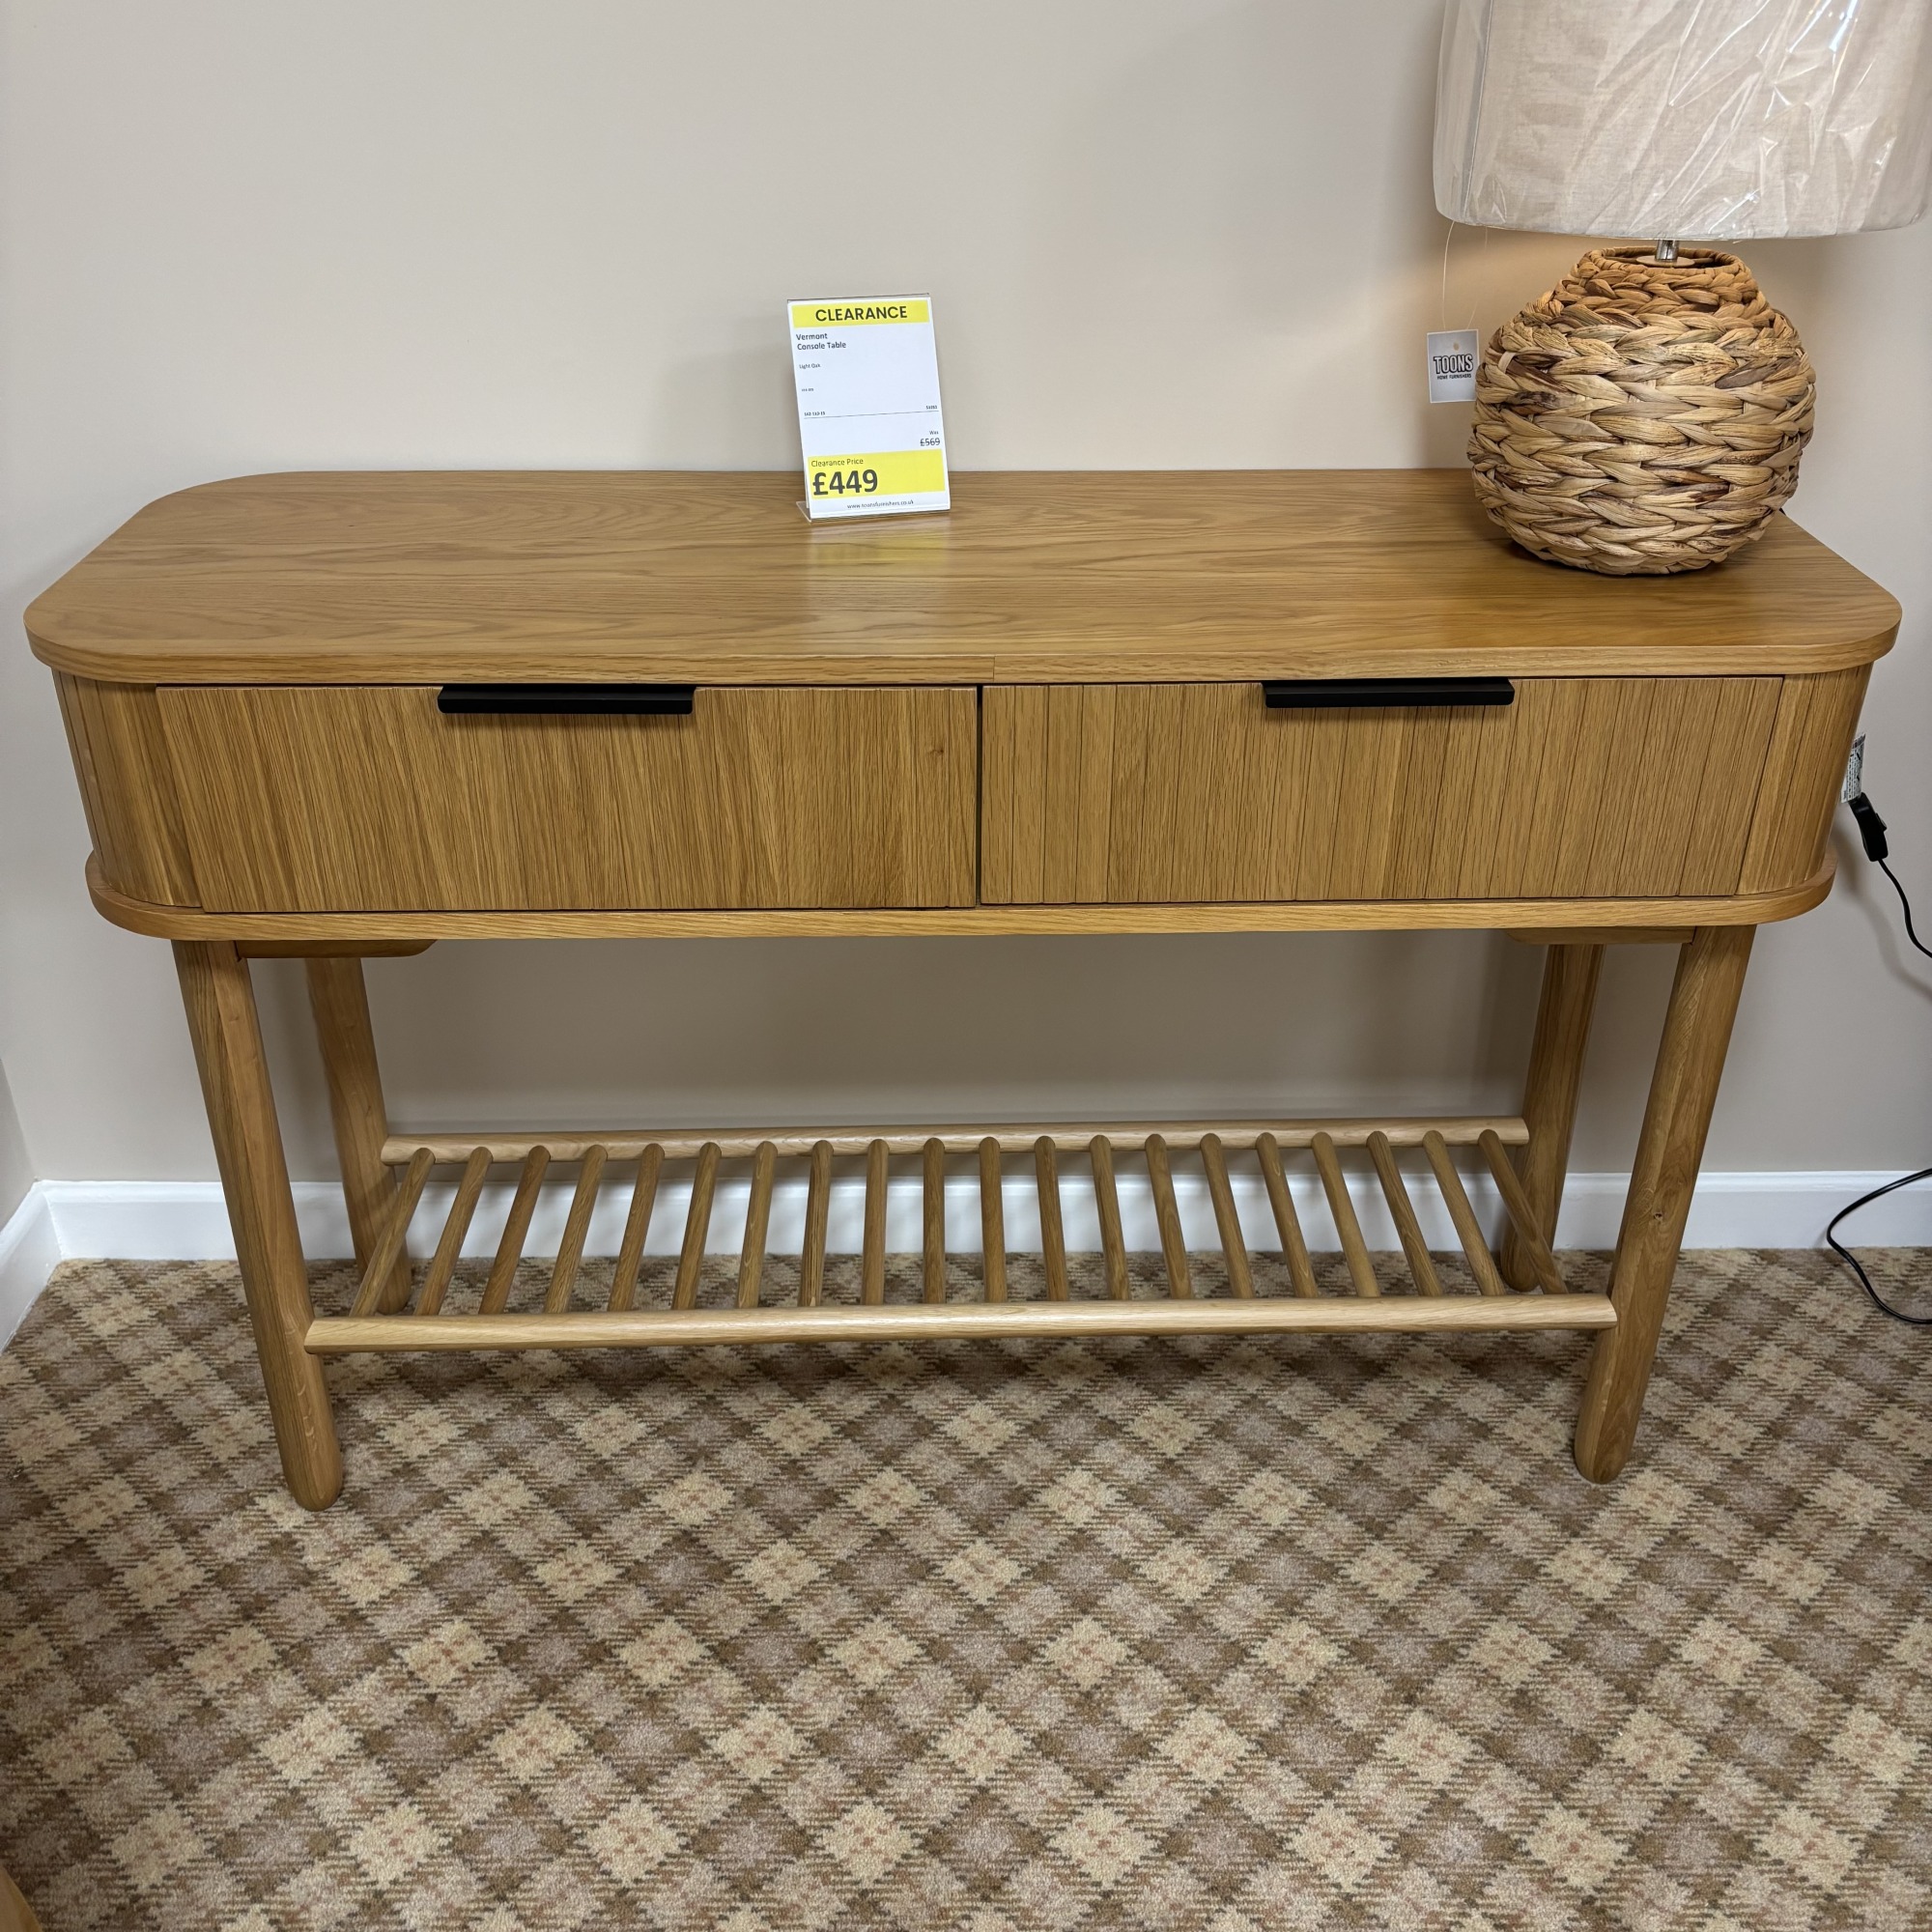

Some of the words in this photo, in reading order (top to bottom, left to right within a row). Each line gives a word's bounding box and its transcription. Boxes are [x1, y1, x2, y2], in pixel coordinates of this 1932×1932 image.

[815, 305, 908, 322] CLEARANCE
[1433, 354, 1473, 374] TOONS
[920, 437, 941, 446] £569
[811, 458, 845, 468] Clearance
[846, 457, 864, 466] Price
[812, 469, 878, 496] £449
